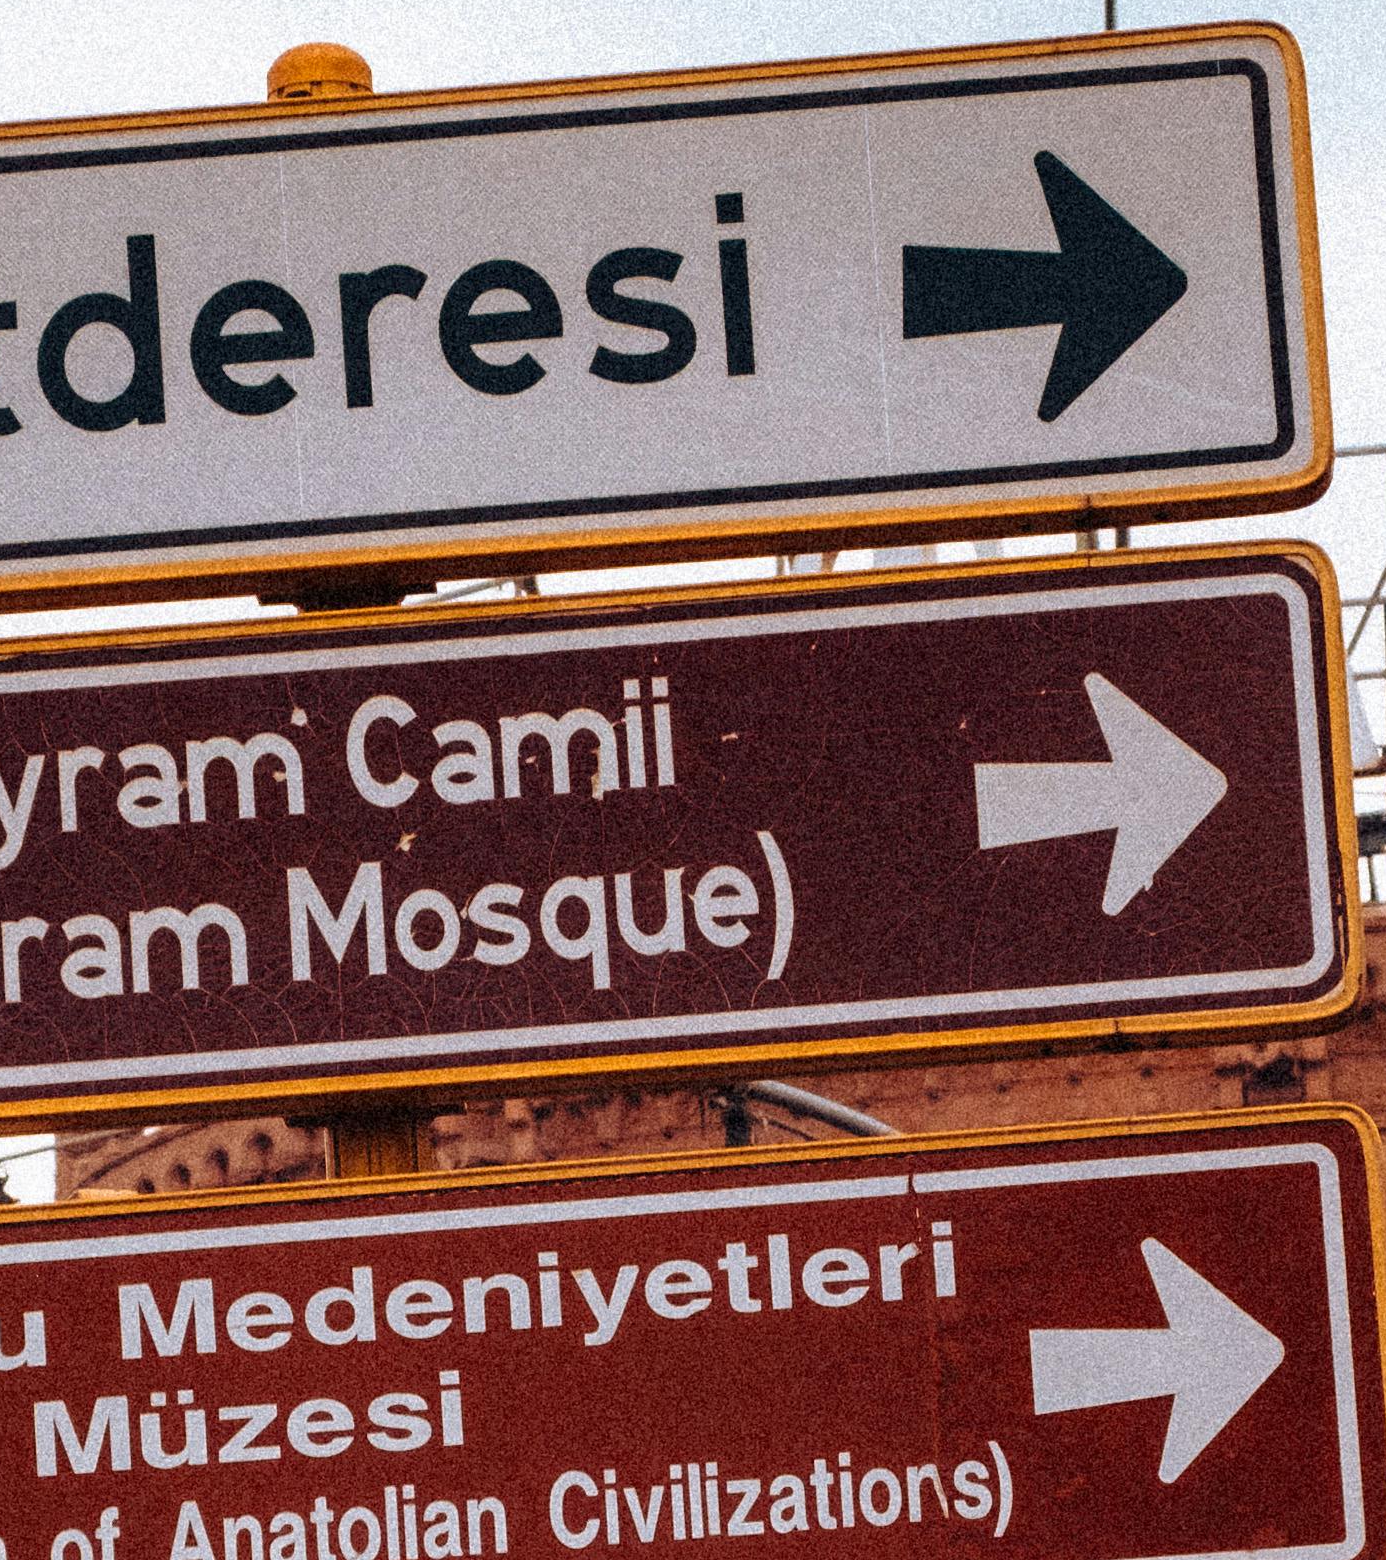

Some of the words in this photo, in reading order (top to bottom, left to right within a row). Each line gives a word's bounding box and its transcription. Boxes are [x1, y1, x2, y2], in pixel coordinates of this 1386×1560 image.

[345, 674, 681, 812] Camii
[287, 828, 797, 992] Mosque)
[116, 1219, 959, 1366] Medeniyetleri
[32, 1368, 468, 1480] Müzesi
[549, 1438, 1020, 1552] Civilizations)
